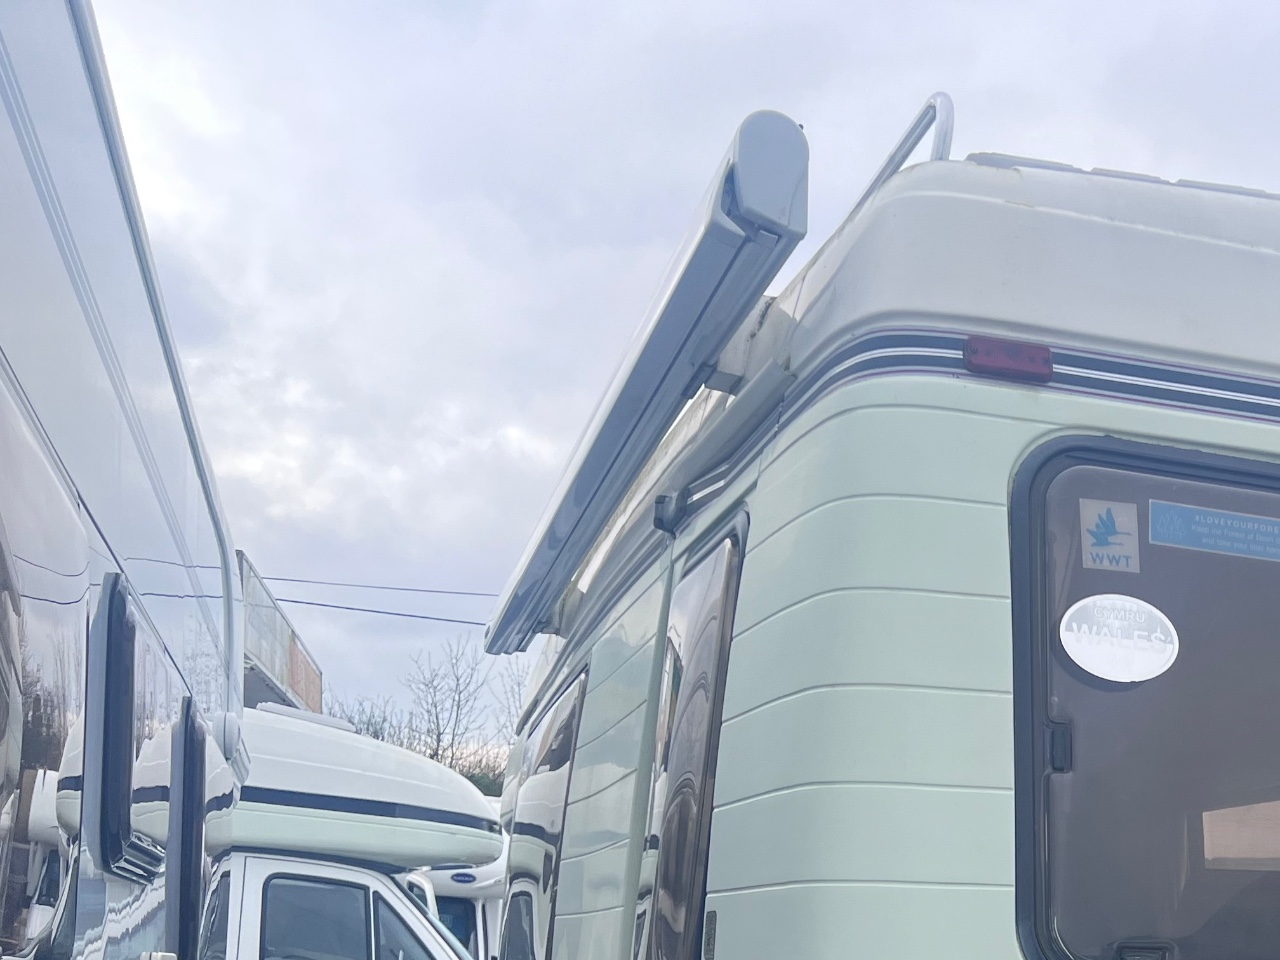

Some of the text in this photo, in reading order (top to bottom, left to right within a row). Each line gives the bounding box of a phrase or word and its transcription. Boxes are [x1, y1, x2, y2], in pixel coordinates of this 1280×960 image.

[1191, 523, 1210, 534] Keep
[1224, 528, 1246, 540] Forest
[1090, 551, 1133, 568] WWT
[1093, 607, 1146, 623] CYMRU
[1071, 622, 1168, 654] WALES
